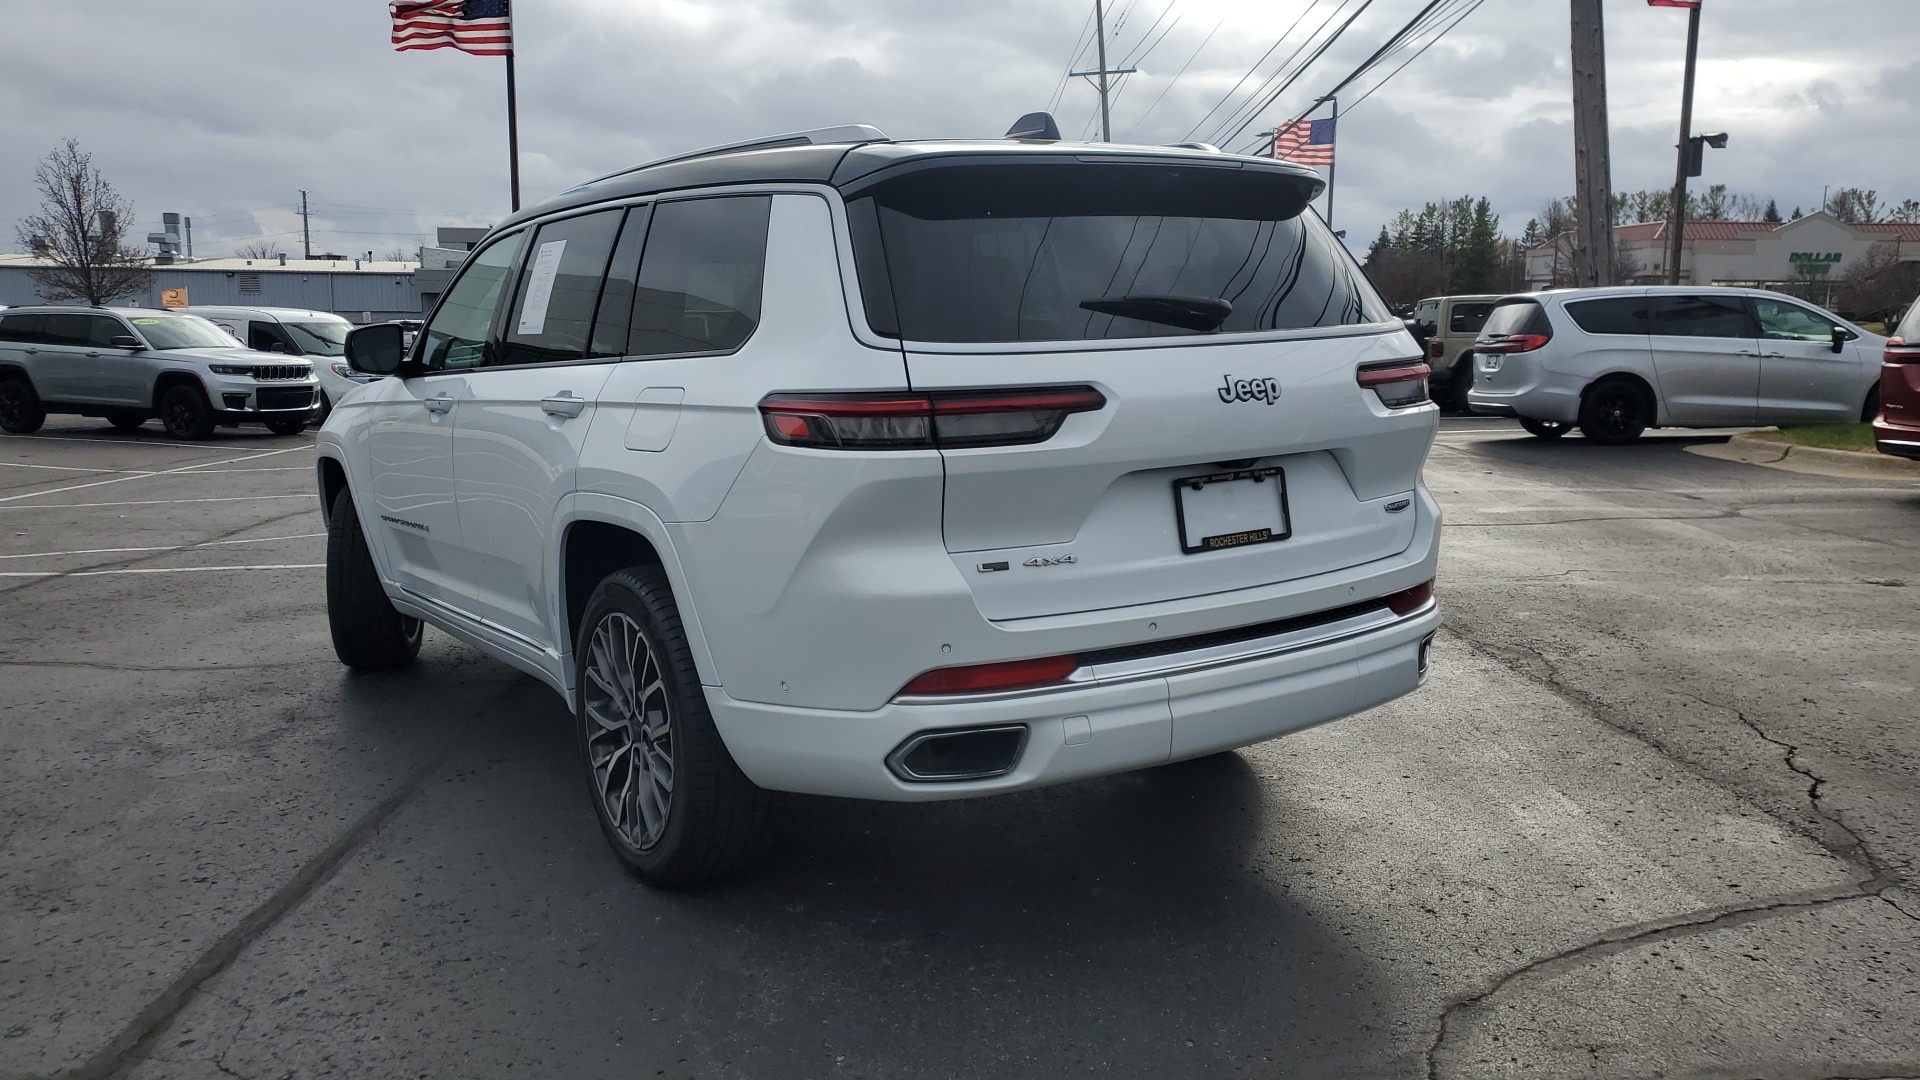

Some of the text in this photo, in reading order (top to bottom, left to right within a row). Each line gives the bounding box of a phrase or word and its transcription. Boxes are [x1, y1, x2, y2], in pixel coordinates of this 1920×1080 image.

[1789, 252, 1842, 262] DOLLAR
[1218, 374, 1281, 405] Jeep
[1209, 530, 1268, 548] ROCHESTER HILLS
[1022, 554, 1078, 567] 4x4
